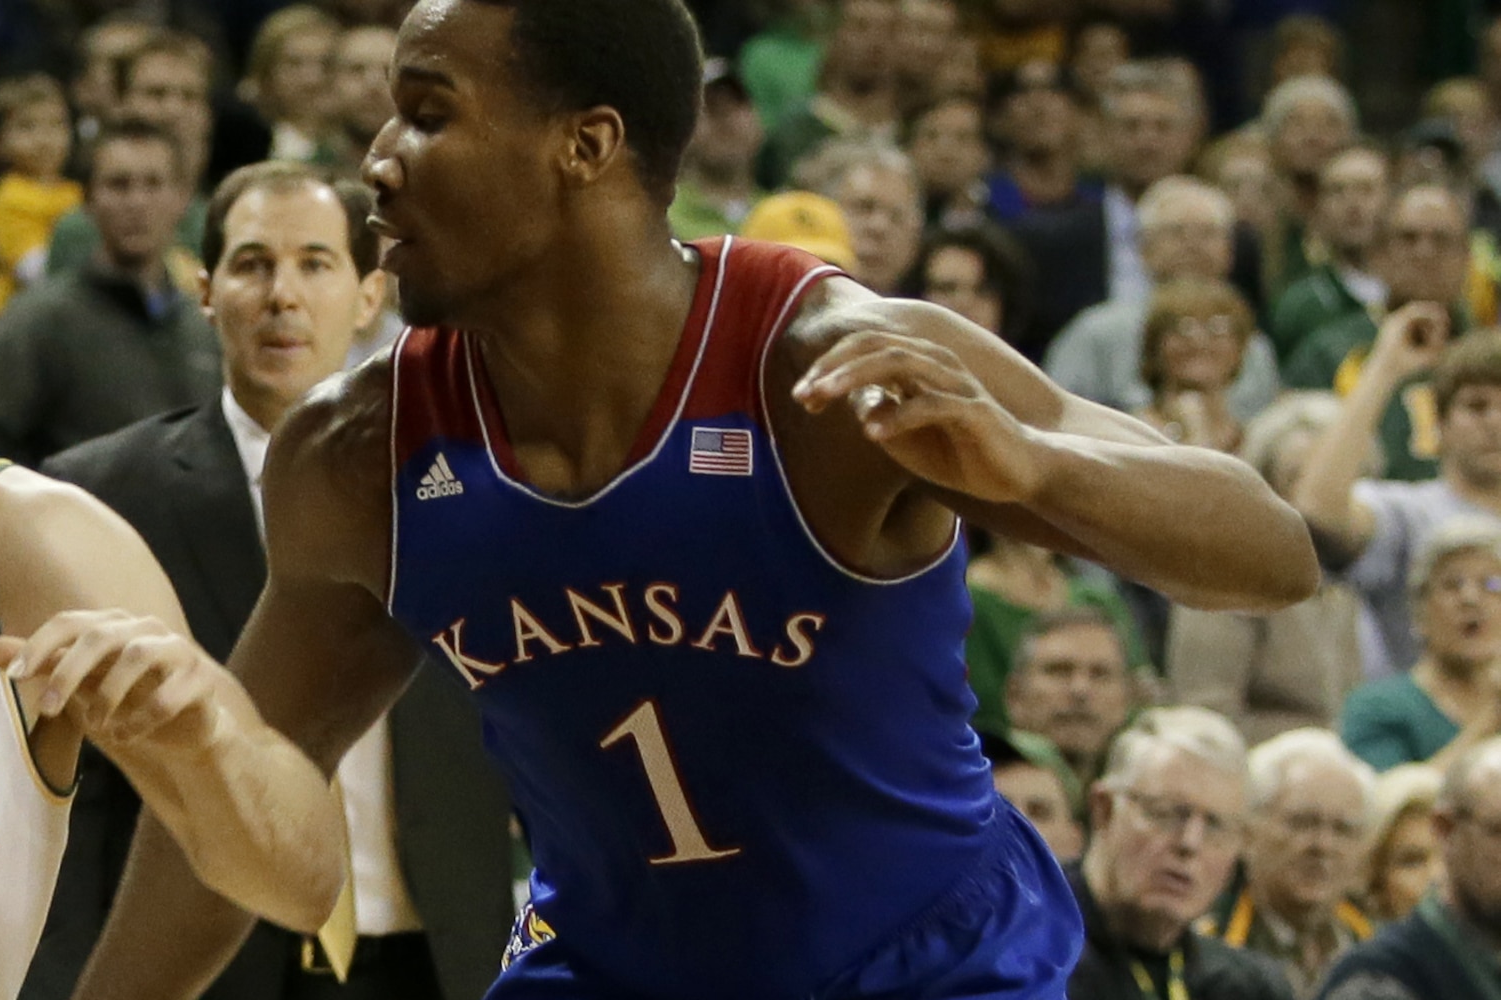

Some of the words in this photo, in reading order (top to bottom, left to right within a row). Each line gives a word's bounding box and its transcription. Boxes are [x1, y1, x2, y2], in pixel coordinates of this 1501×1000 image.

[416, 480, 464, 500] adidas
[431, 575, 826, 691] KANSAS
[599, 698, 741, 865] 1
